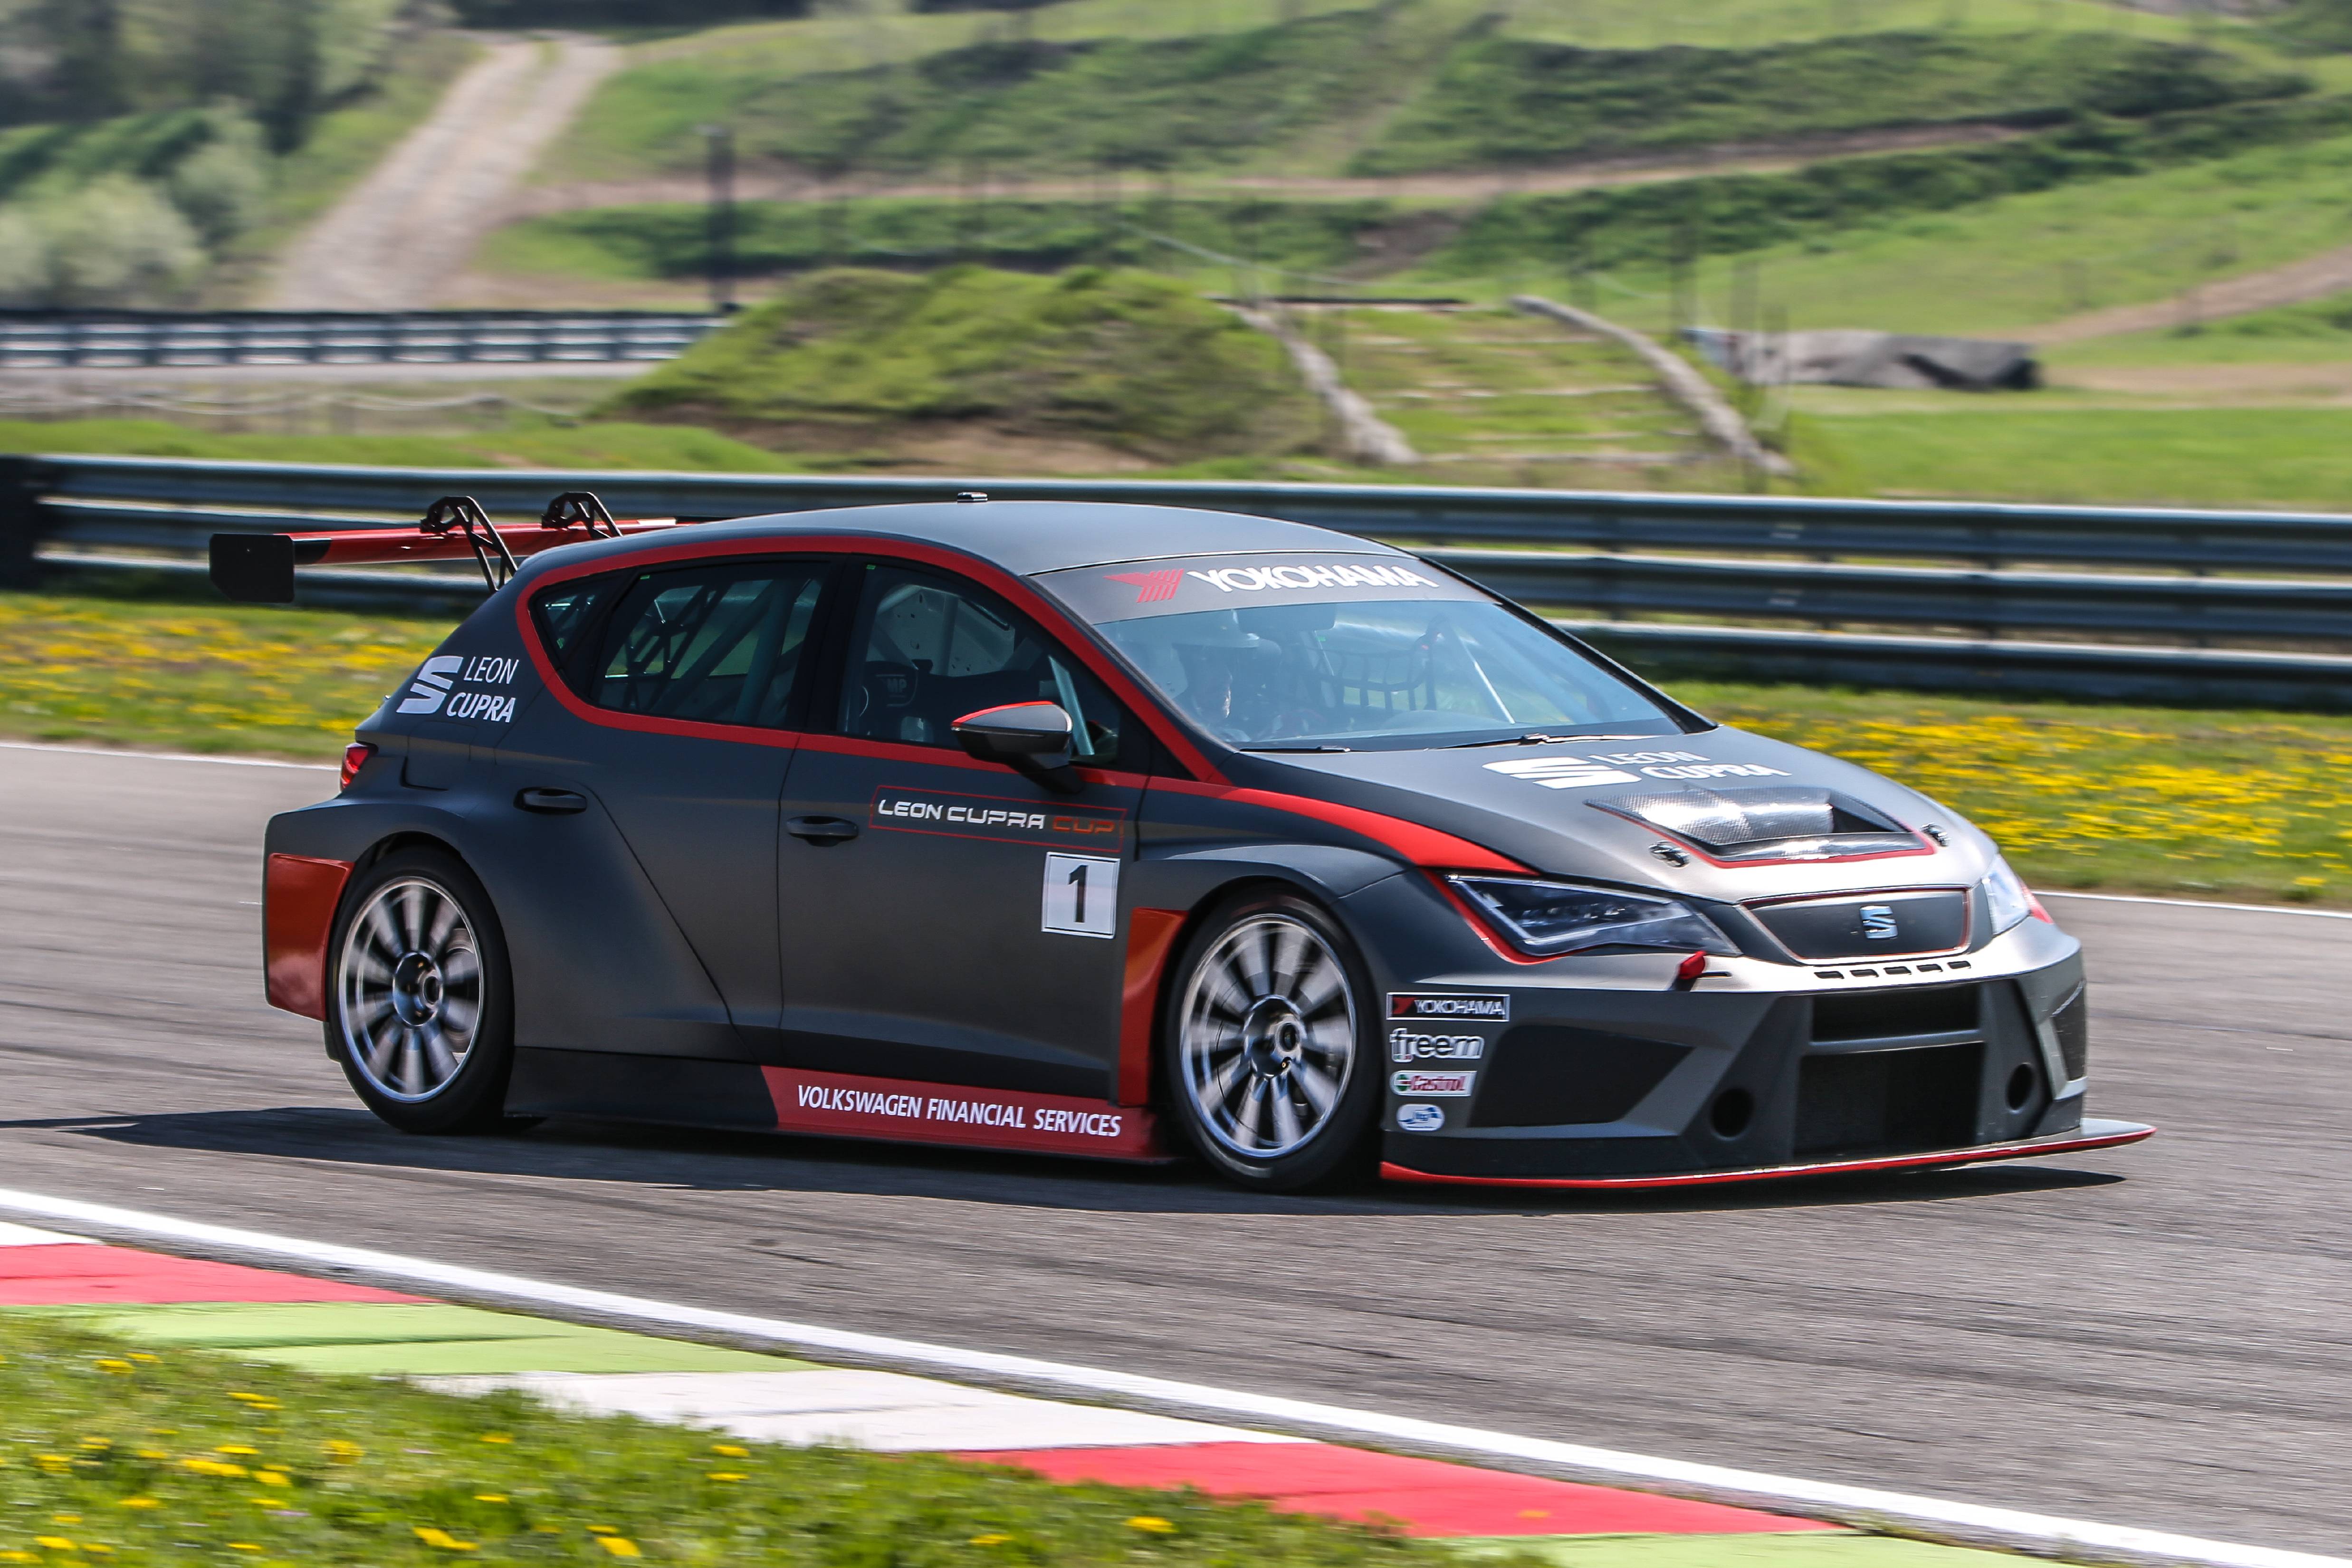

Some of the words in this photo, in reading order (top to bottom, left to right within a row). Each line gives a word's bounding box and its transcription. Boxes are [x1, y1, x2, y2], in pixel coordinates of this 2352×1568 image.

[1187, 565, 1440, 593] YOKOHAMA
[463, 656, 519, 684] LEON
[446, 692, 516, 723] CUPRA
[1587, 751, 1711, 765] LEON
[1639, 764, 1793, 779] CUPRA
[878, 799, 944, 820] LEON
[947, 806, 1047, 830] CUPRA
[1052, 816, 1116, 834] CUP
[1067, 864, 1090, 924] 1
[1414, 999, 1505, 1015] YOKOHAMA
[1389, 1028, 1484, 1063] freem
[797, 1084, 923, 1119] VOLKSWAGEN
[926, 1098, 1026, 1129] FINANCIAL
[1032, 1109, 1122, 1138] SERVICES
